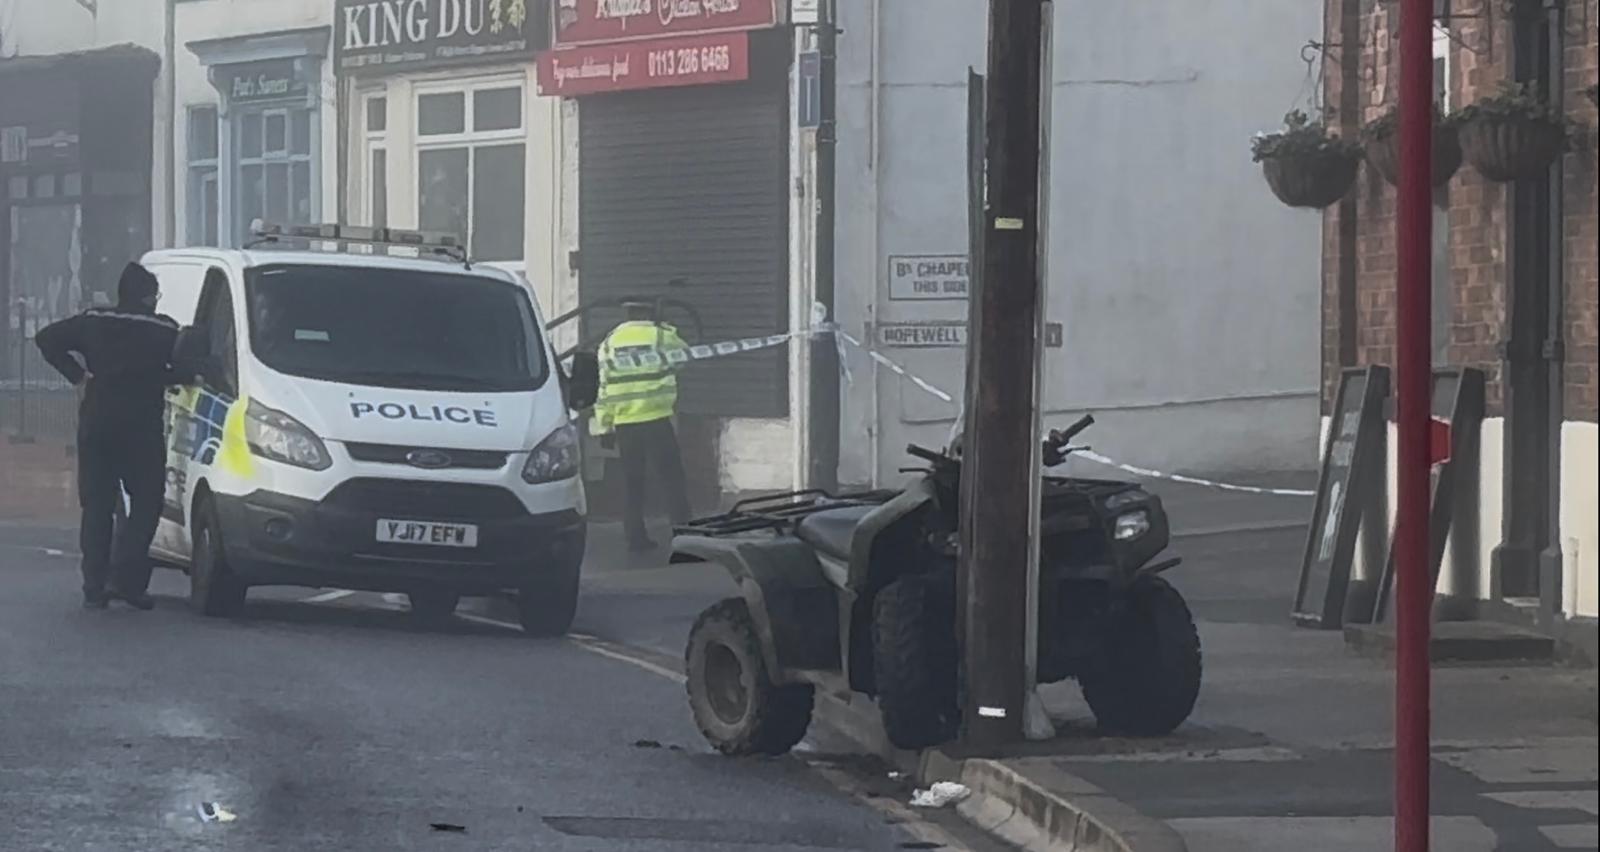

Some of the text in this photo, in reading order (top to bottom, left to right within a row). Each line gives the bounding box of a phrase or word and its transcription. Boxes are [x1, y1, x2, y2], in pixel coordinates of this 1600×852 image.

[342, 0, 486, 50] KING DU
[648, 49, 675, 77] 0113
[677, 47, 698, 75] 286
[913, 280, 938, 293] THIS
[885, 327, 960, 343] HOPEWELL
[350, 402, 498, 427] POLICE
